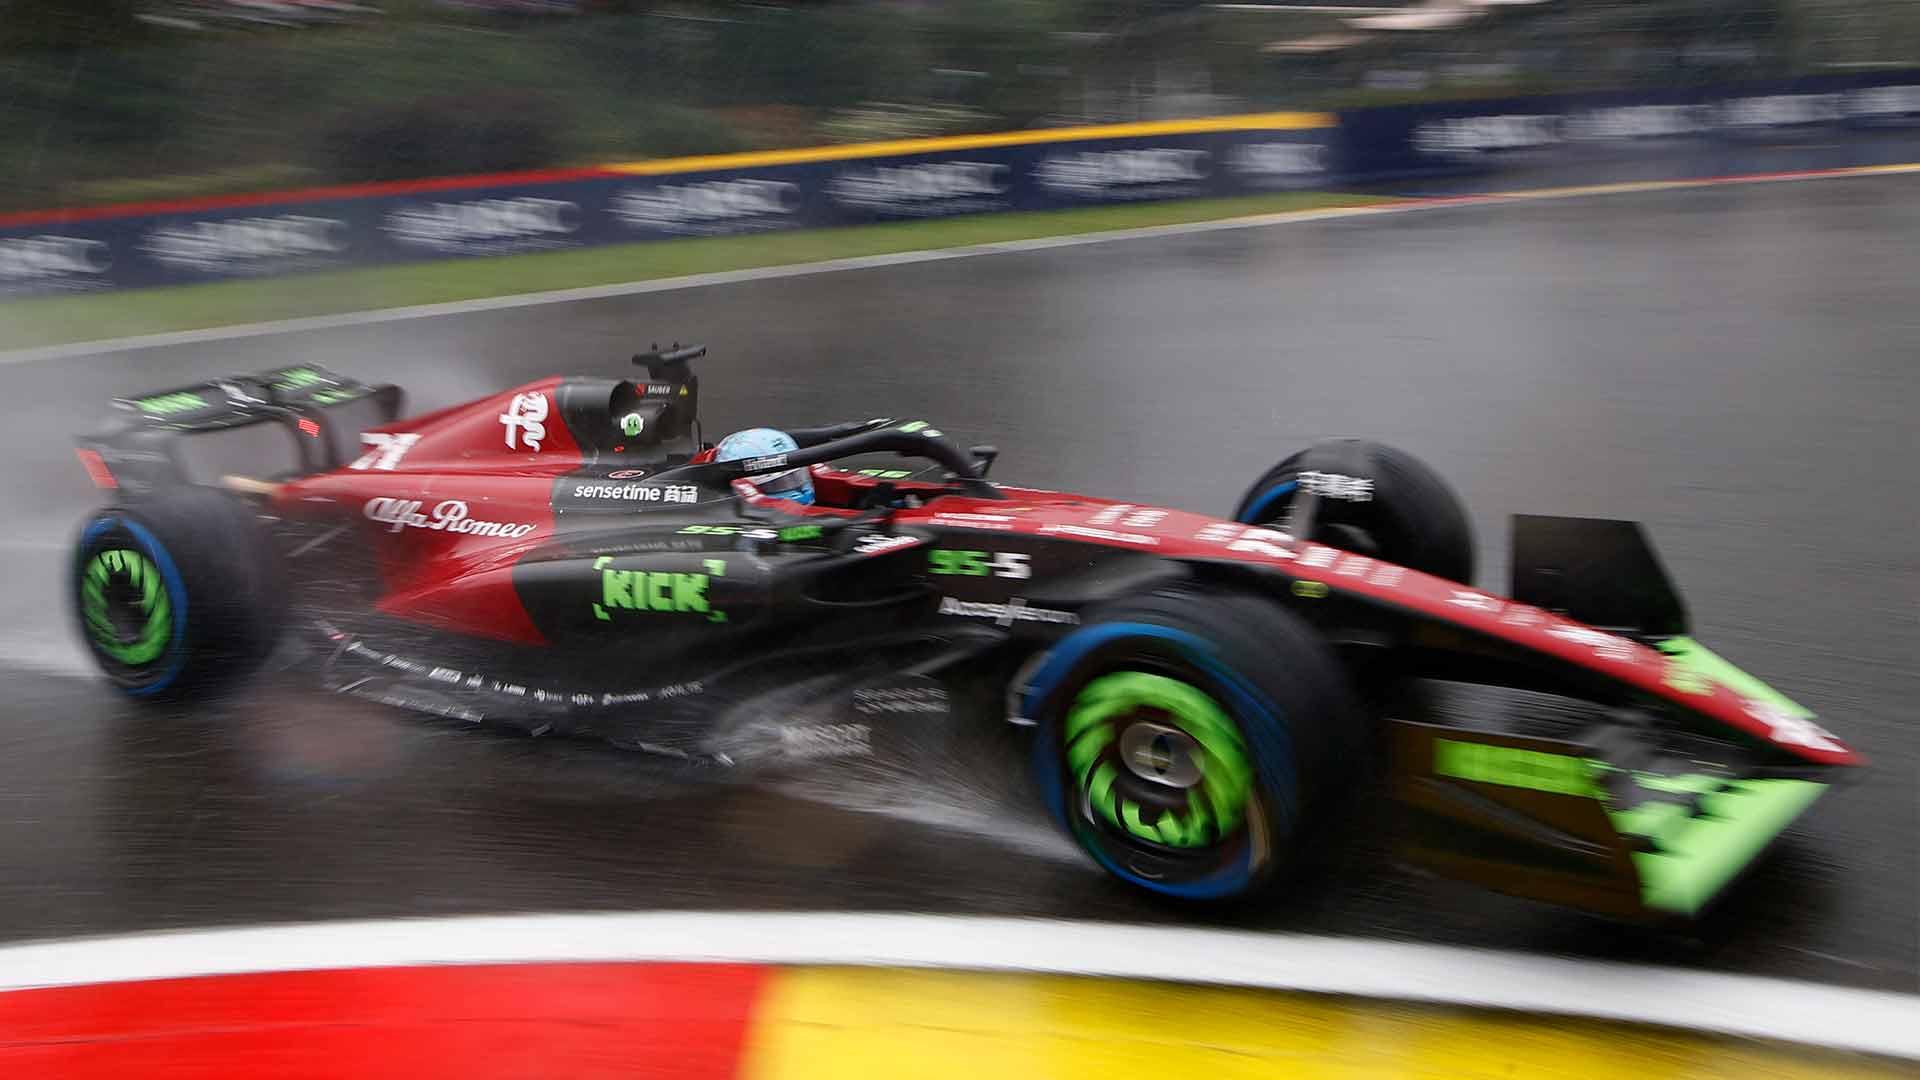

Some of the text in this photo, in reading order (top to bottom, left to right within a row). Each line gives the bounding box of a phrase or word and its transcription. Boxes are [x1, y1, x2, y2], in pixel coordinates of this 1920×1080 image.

[574, 484, 661, 501] sensetime
[431, 500, 538, 538] Romeo
[602, 569, 710, 612] KICK
